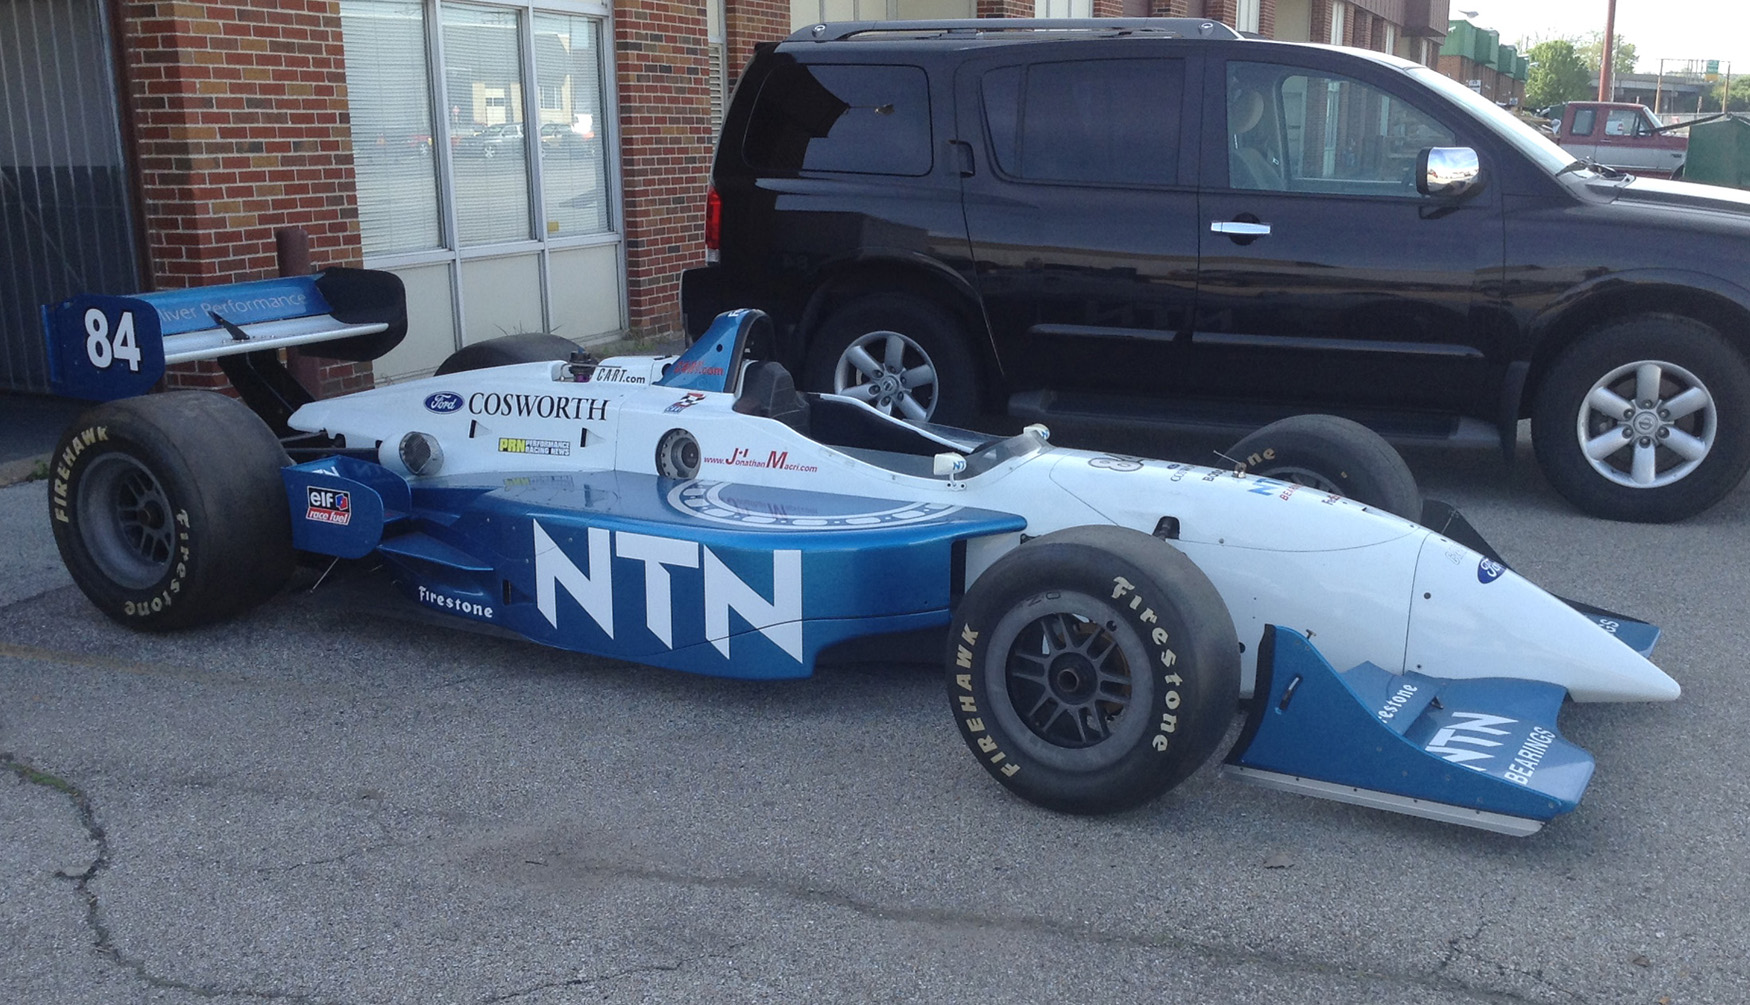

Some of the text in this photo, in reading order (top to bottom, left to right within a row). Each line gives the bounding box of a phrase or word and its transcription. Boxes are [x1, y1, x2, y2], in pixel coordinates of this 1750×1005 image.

[201, 293, 307, 318] Performance
[84, 308, 141, 372] 84
[428, 391, 610, 421] Ford COSWORTH
[596, 367, 646, 385] CART.com
[55, 426, 109, 523] FIREHAWK
[500, 438, 525, 453] PRN
[309, 510, 348, 523] race fuel
[310, 491, 334, 508] elf
[124, 508, 190, 618] Firestone
[533, 518, 803, 664] NTN
[418, 586, 494, 618] Firestone
[1111, 576, 1184, 752] Firestone
[956, 623, 1021, 778] FIREHAWK
[1424, 711, 1519, 772] NTN
[1503, 725, 1557, 786] BEARINGS
